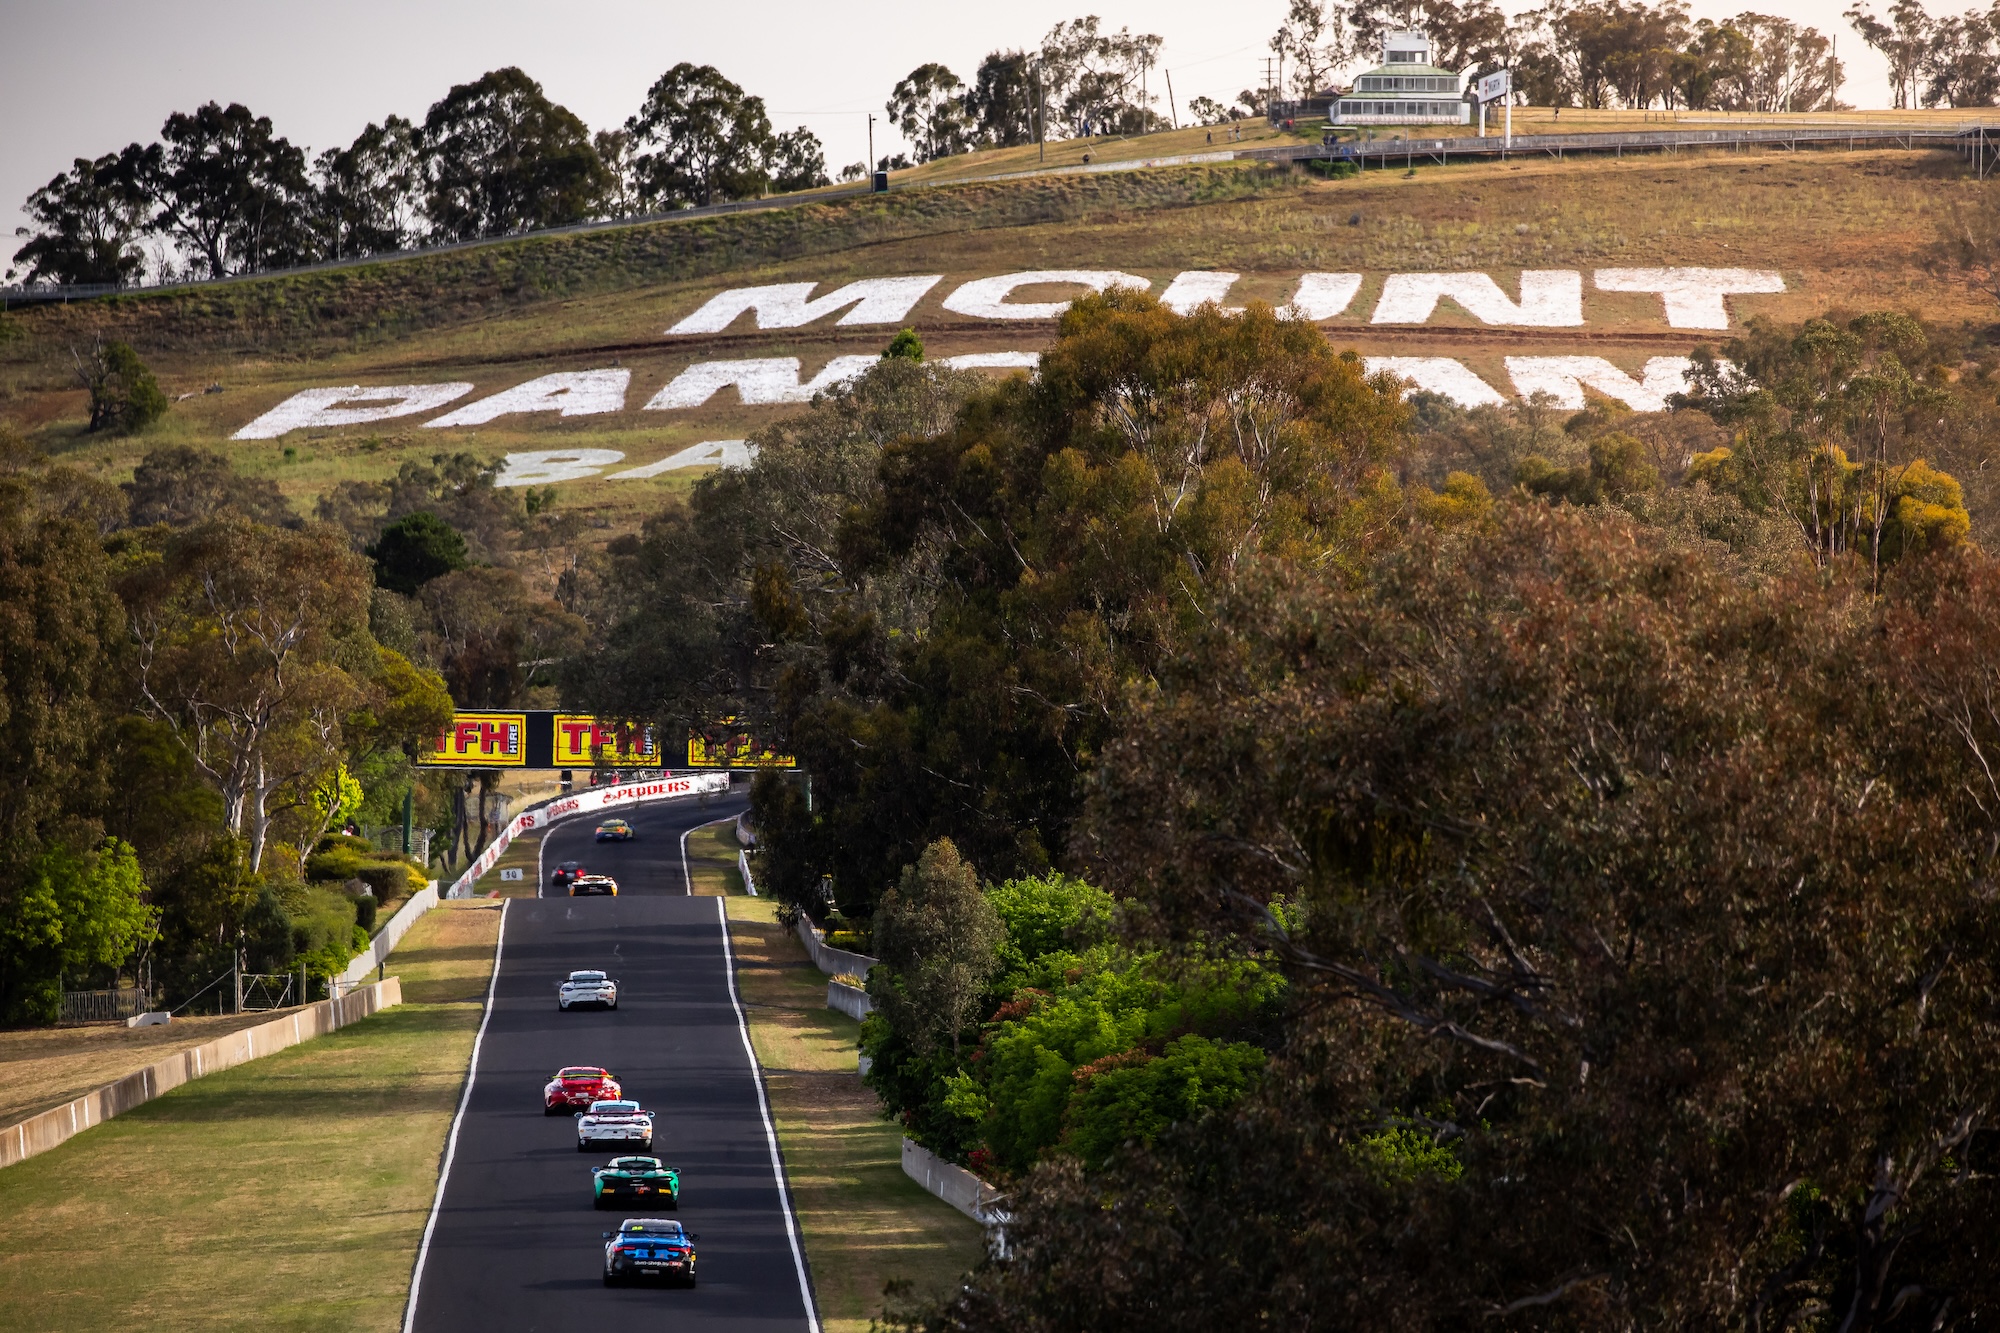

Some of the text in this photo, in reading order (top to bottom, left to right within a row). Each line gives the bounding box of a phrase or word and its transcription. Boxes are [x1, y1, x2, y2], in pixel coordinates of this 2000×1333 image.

[664, 267, 1786, 335] MOUNT
[509, 725, 518, 754] HIRE
[618, 780, 690, 799] PEDDERS
